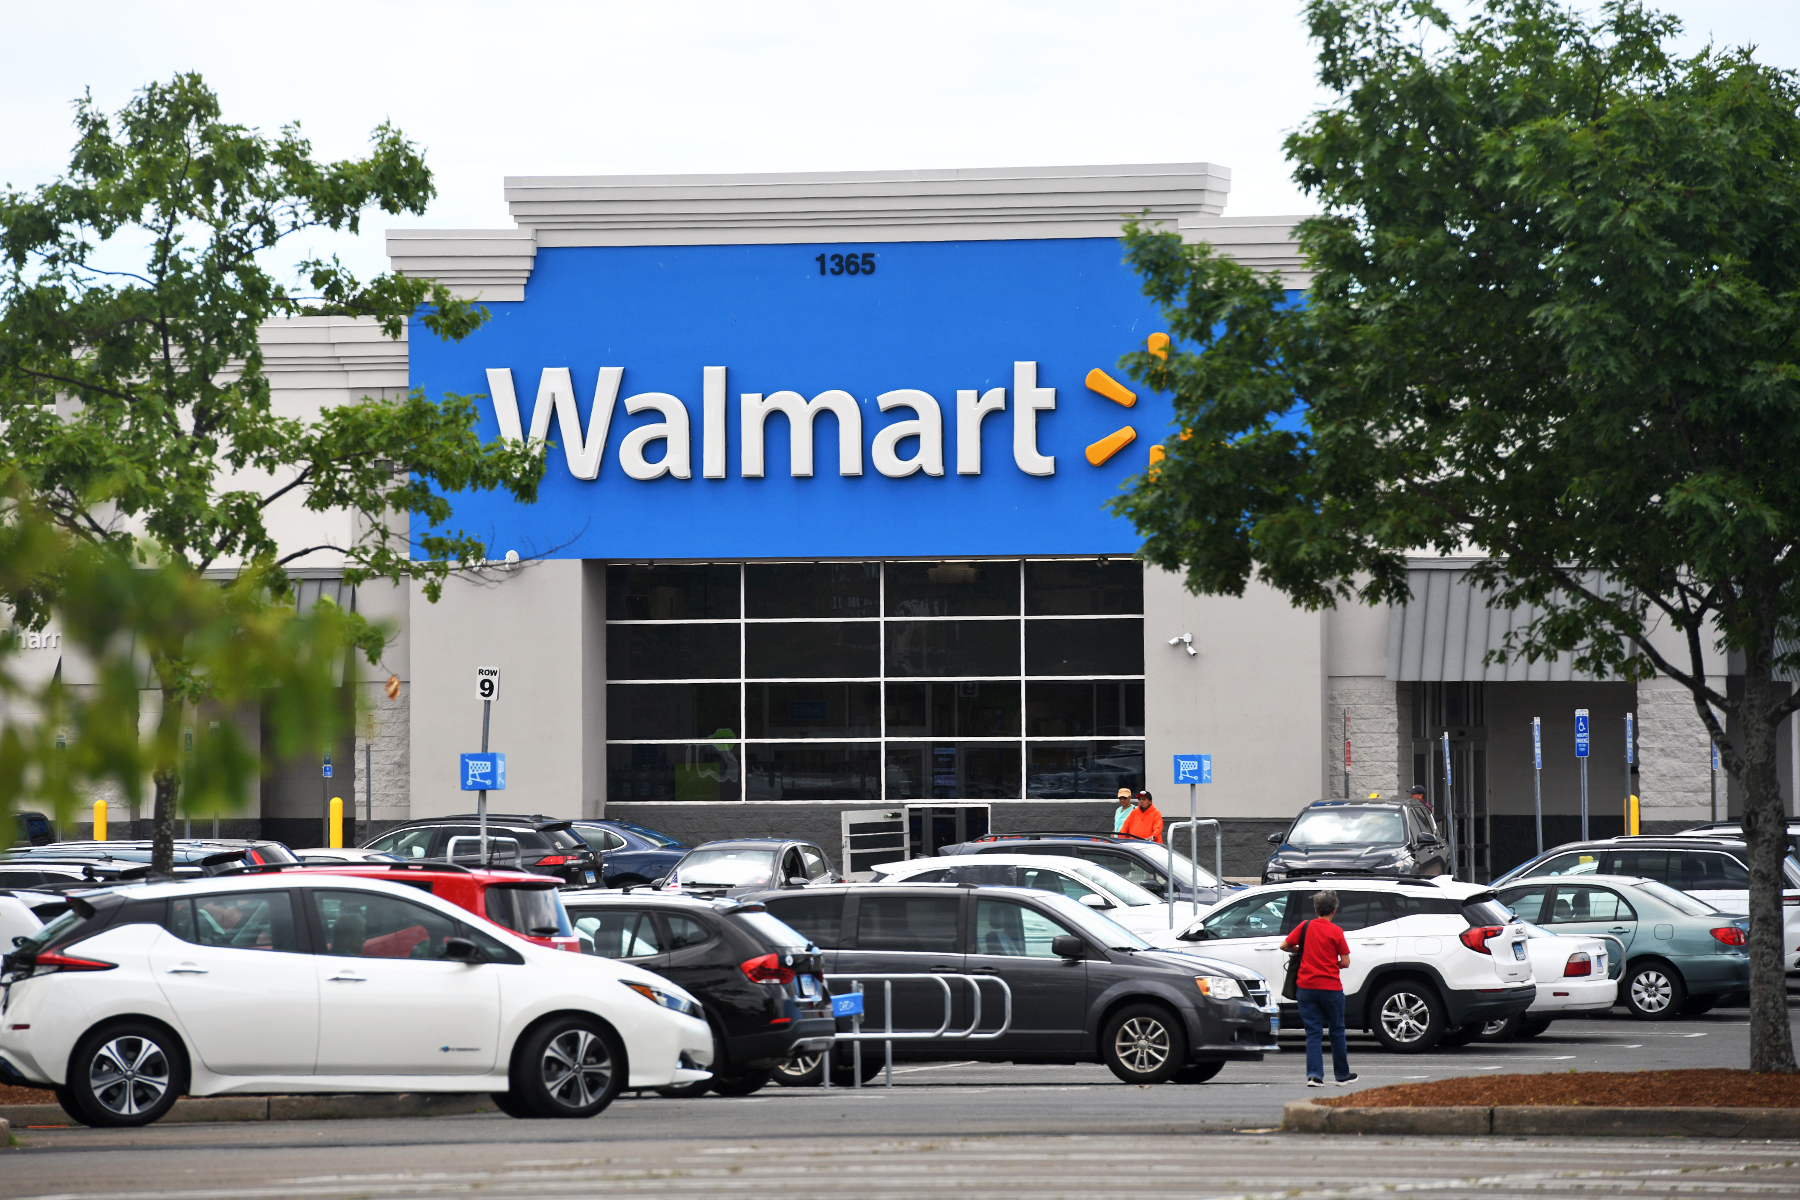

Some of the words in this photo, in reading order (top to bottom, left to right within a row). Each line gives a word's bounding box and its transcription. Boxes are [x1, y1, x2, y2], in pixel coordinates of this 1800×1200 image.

[815, 252, 876, 275] 1365
[485, 361, 1056, 480] Walmart
[478, 668, 498, 676] ROW
[479, 678, 495, 698] 9
